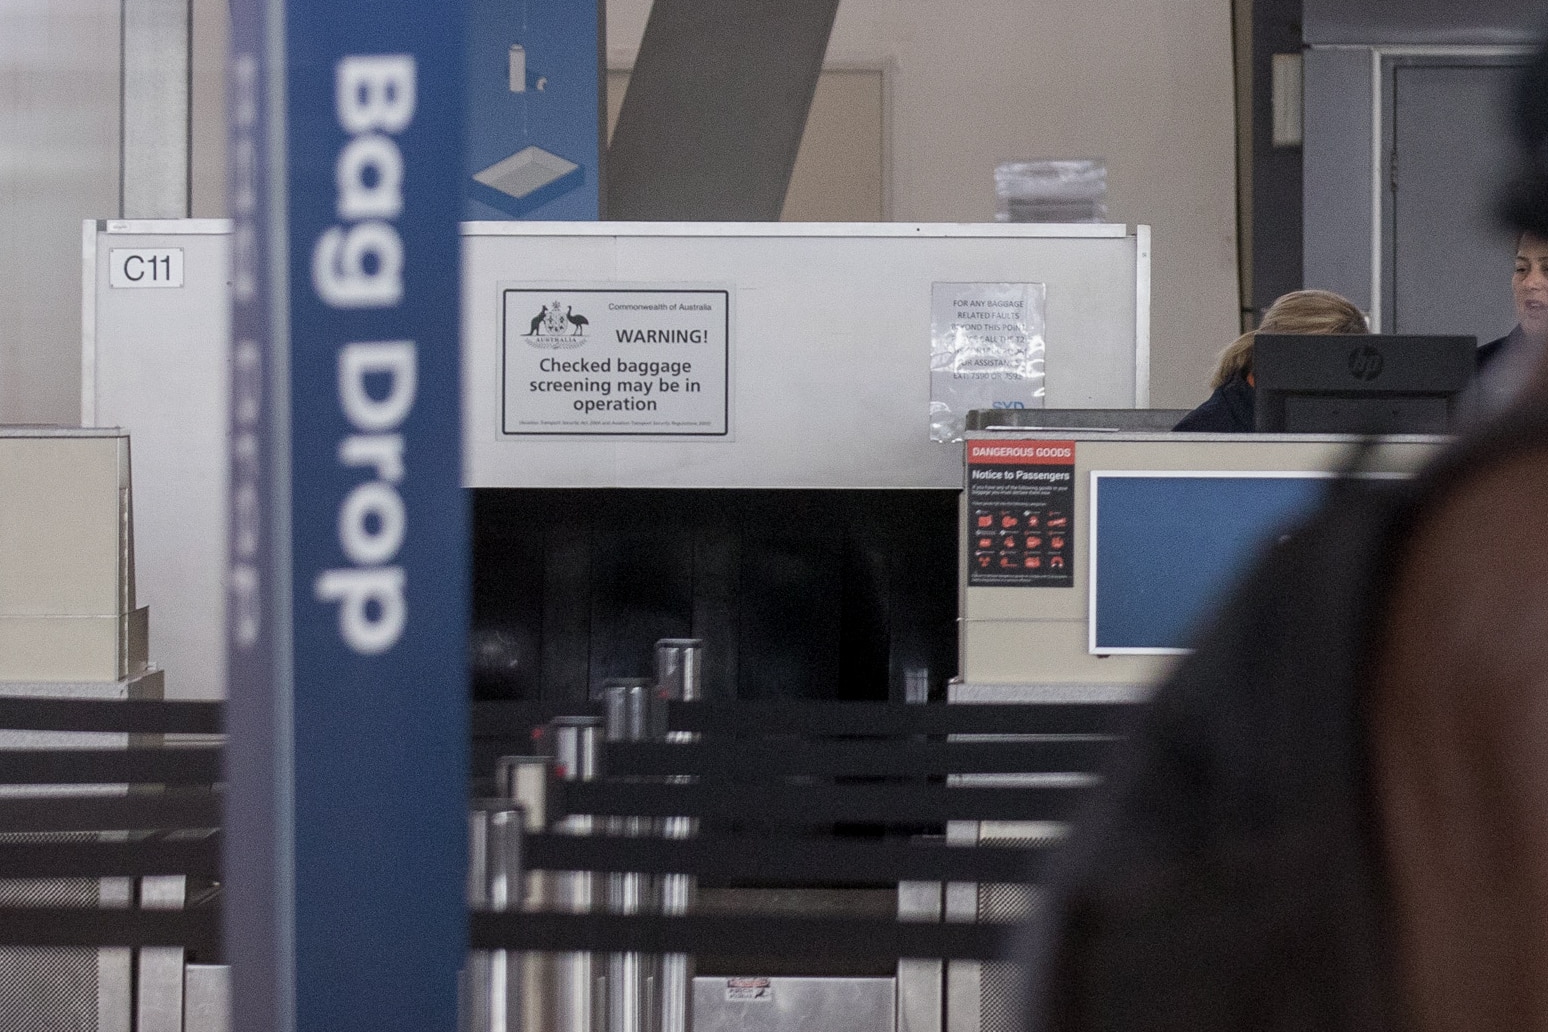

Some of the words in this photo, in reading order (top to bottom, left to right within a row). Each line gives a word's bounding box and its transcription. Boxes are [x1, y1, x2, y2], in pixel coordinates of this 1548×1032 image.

[313, 54, 417, 308] Bag
[123, 255, 173, 282] C11
[608, 302, 668, 311] Commonwealth
[668, 302, 677, 311] of
[678, 302, 713, 311] Australia
[953, 300, 968, 308] FOR
[970, 300, 985, 308] ANY
[987, 300, 1024, 308] BAGGAGE
[957, 311, 990, 320] RELATED
[991, 312, 1020, 320] FAULTS
[984, 323, 1001, 331] THIS
[616, 328, 708, 344] WARNING!
[539, 357, 611, 372] Checked
[617, 357, 692, 376] baggage
[529, 378, 612, 395] screening
[617, 380, 653, 395] may
[659, 378, 680, 392] be
[685, 378, 701, 392] in
[573, 397, 657, 413] operation
[972, 447, 1034, 457] DANGEROUS
[1035, 447, 1071, 457] GOODS
[972, 469, 1002, 479] Notice
[1004, 470, 1014, 479] to
[1015, 470, 1070, 482] Passengers
[315, 340, 417, 655] Drop
